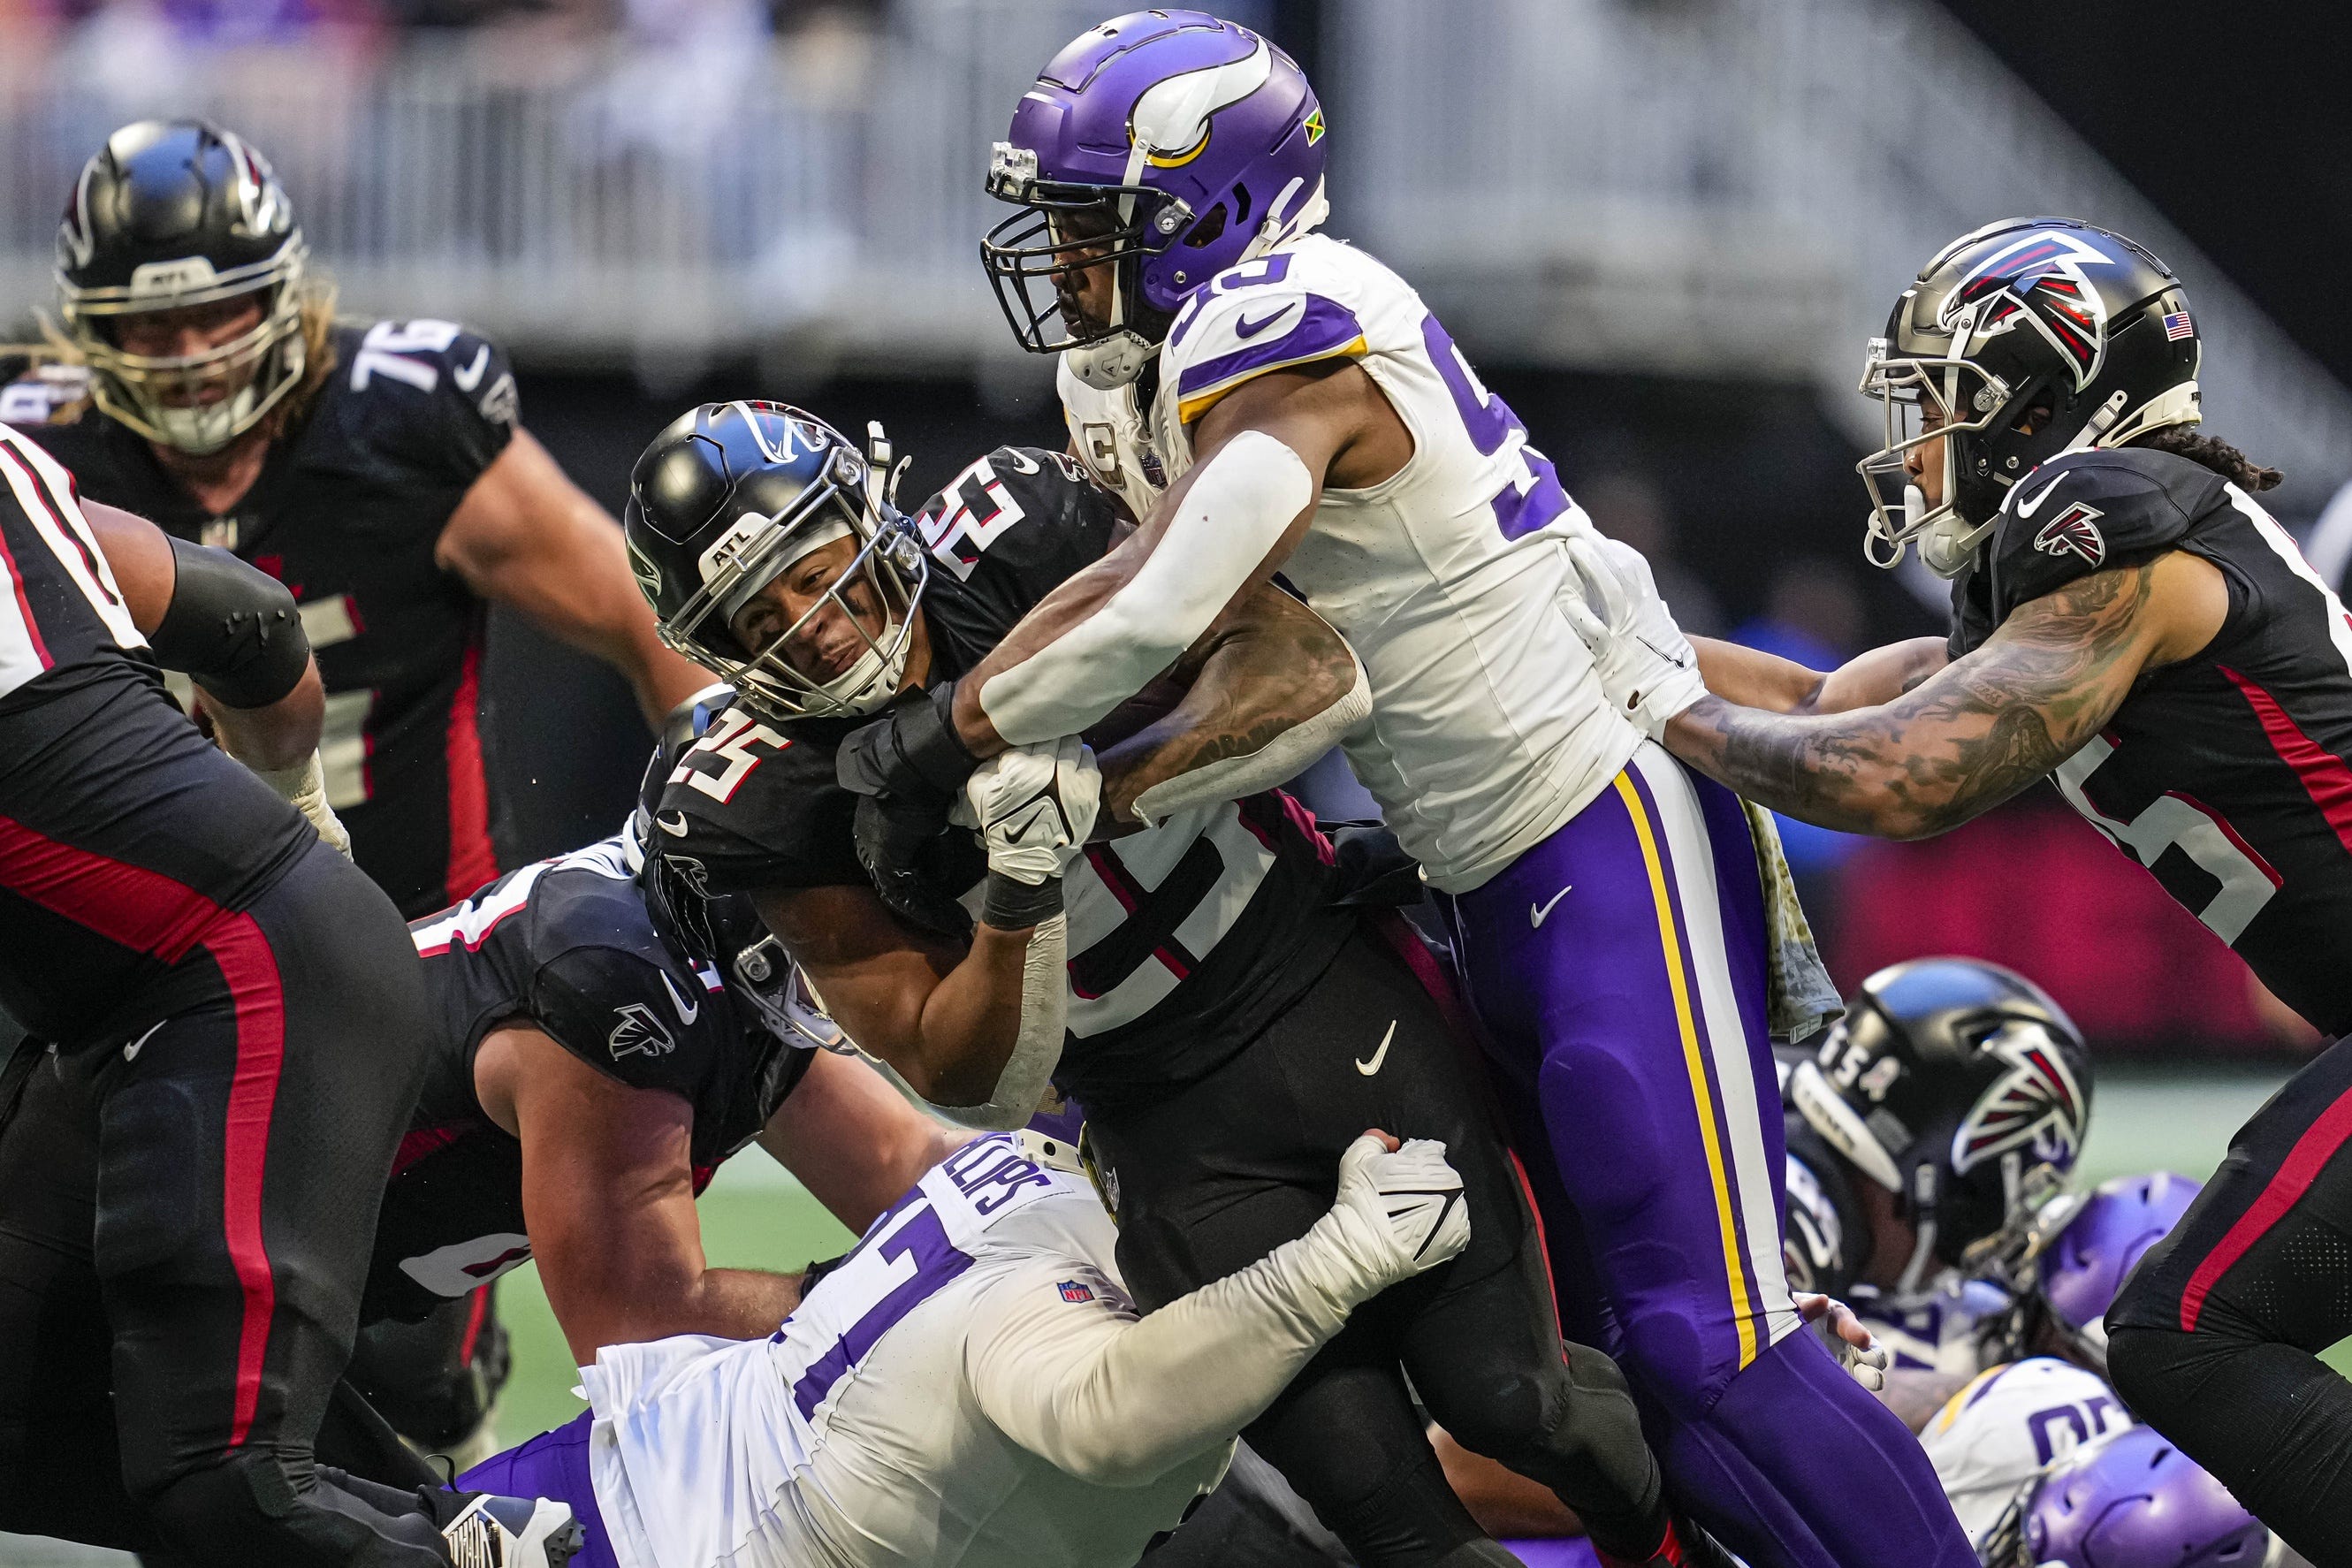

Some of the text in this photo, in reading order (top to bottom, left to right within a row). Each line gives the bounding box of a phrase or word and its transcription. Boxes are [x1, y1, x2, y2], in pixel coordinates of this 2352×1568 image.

[1085, 426, 1115, 472] C
[712, 531, 750, 567] ATL
[666, 707, 794, 806] 25
[767, 1184, 977, 1424] 7
